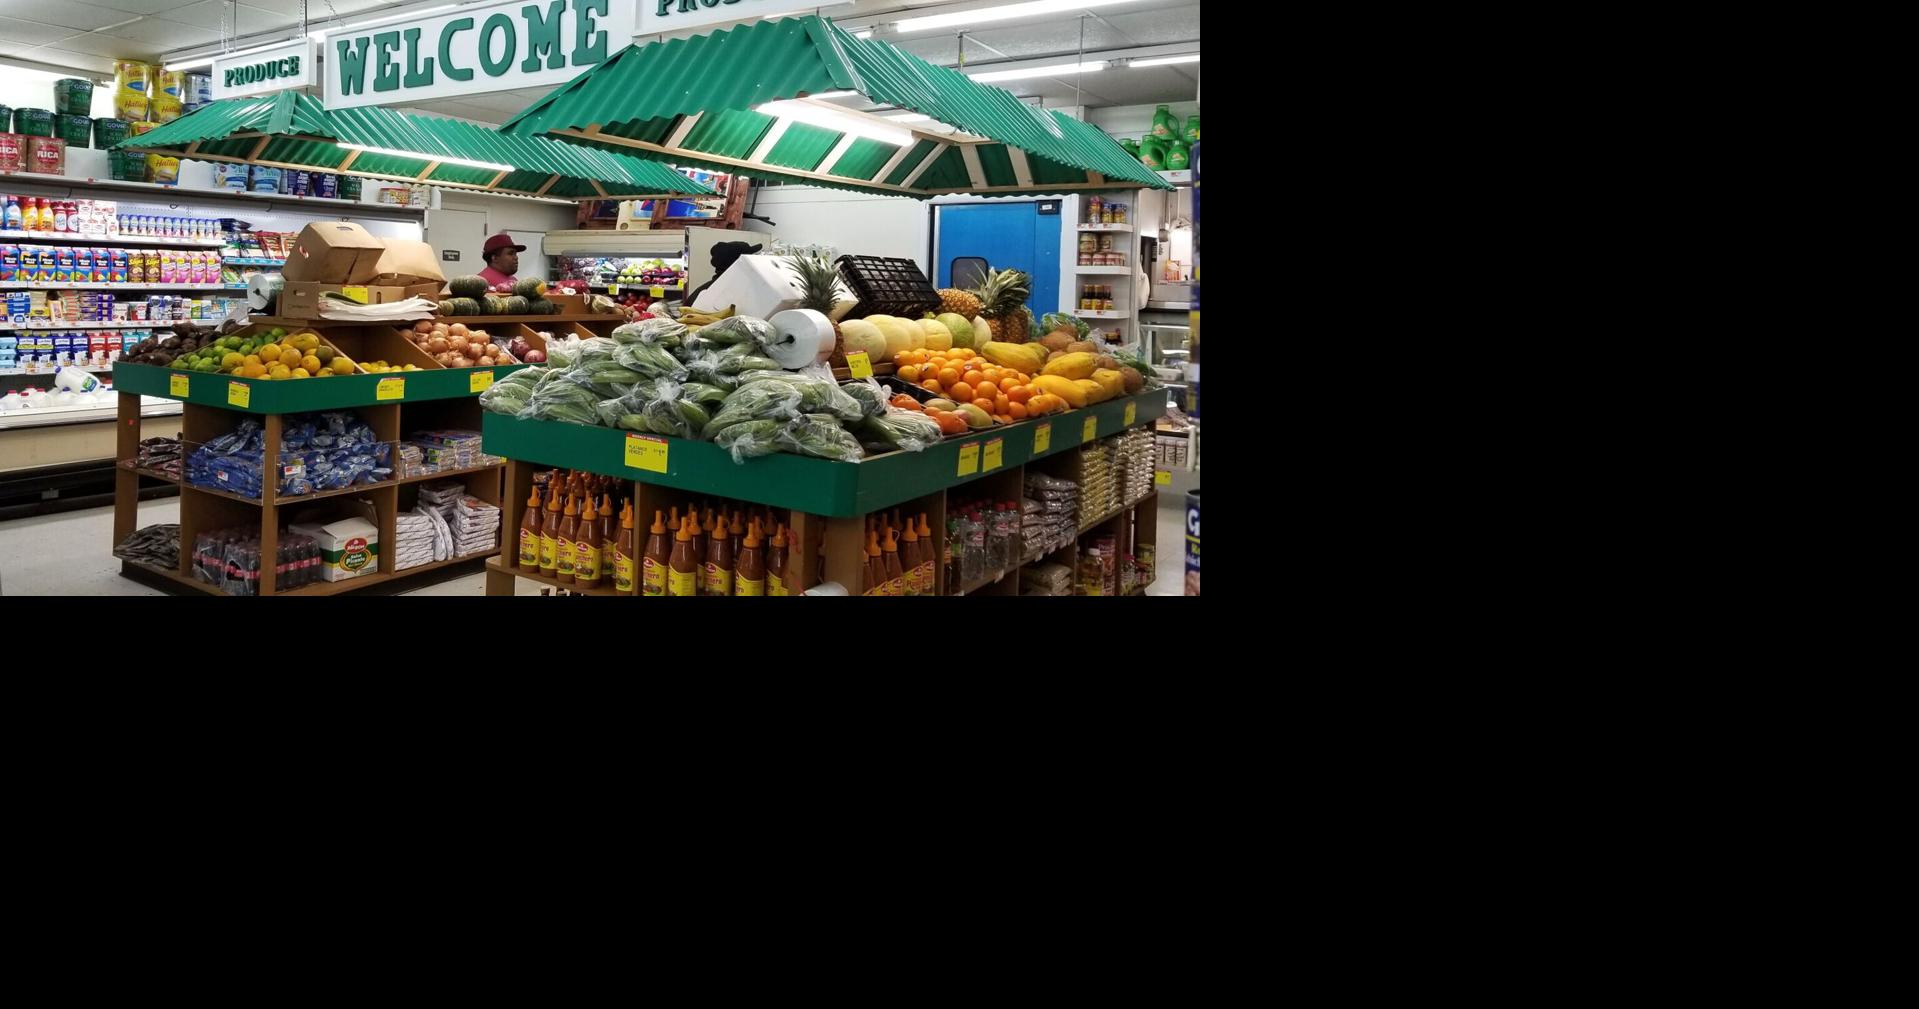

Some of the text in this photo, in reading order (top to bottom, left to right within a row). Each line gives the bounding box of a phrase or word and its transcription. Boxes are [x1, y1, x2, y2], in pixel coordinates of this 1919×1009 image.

[336, 0, 609, 96] WELCOME
[224, 55, 301, 88] PRODUCE
[37, 150, 59, 159] RICA
